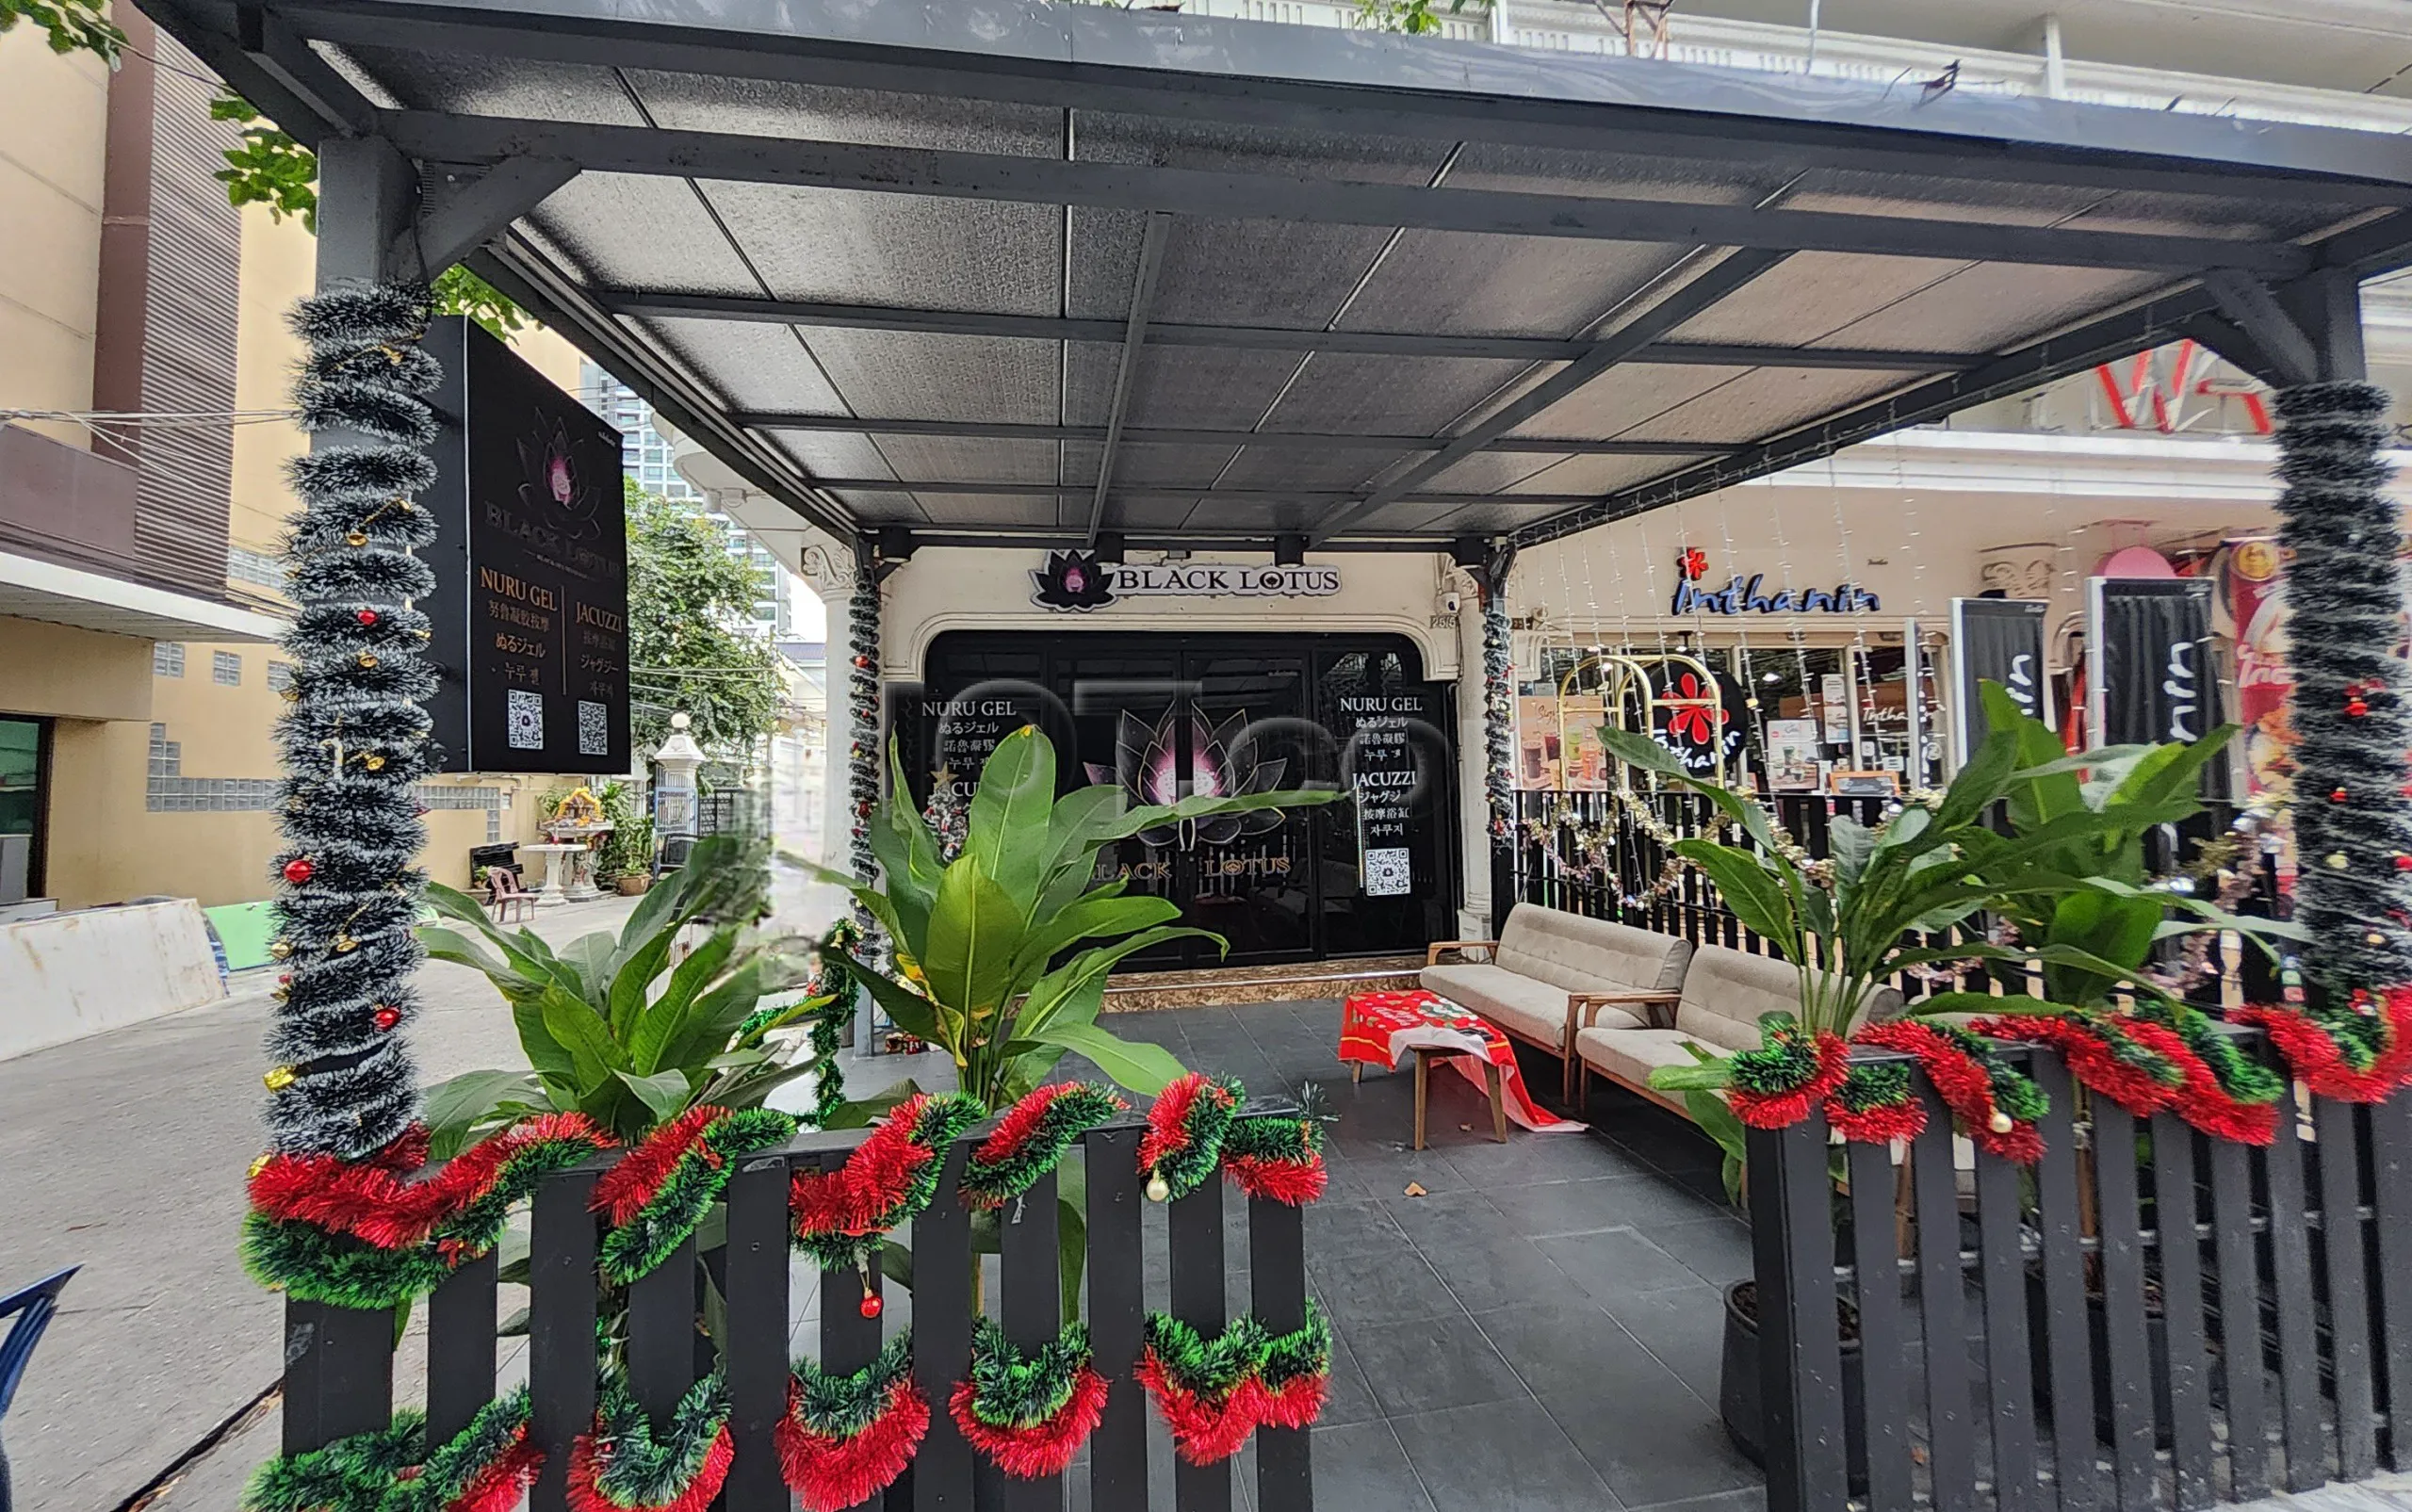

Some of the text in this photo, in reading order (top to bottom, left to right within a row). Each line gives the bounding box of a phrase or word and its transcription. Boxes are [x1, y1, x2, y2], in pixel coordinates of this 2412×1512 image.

[481, 565, 527, 601] NURU
[529, 585, 558, 612] GEL
[1117, 569, 1340, 590] BLACK LOTUS
[1671, 573, 1881, 615] Inthanin
[575, 601, 623, 633] JACUZZI
[495, 631, 546, 658] ぬるジェル
[921, 700, 1017, 717] NURU GEL
[1339, 697, 1423, 712] NURU GEL
[938, 721, 1000, 735] ぬるジェル
[1355, 715, 1409, 729] ぬるジェル
[1351, 771, 1417, 790] JACUZZI
[1369, 822, 1404, 837] 자쿠지
[1091, 855, 1292, 882] LACK LOTUS
